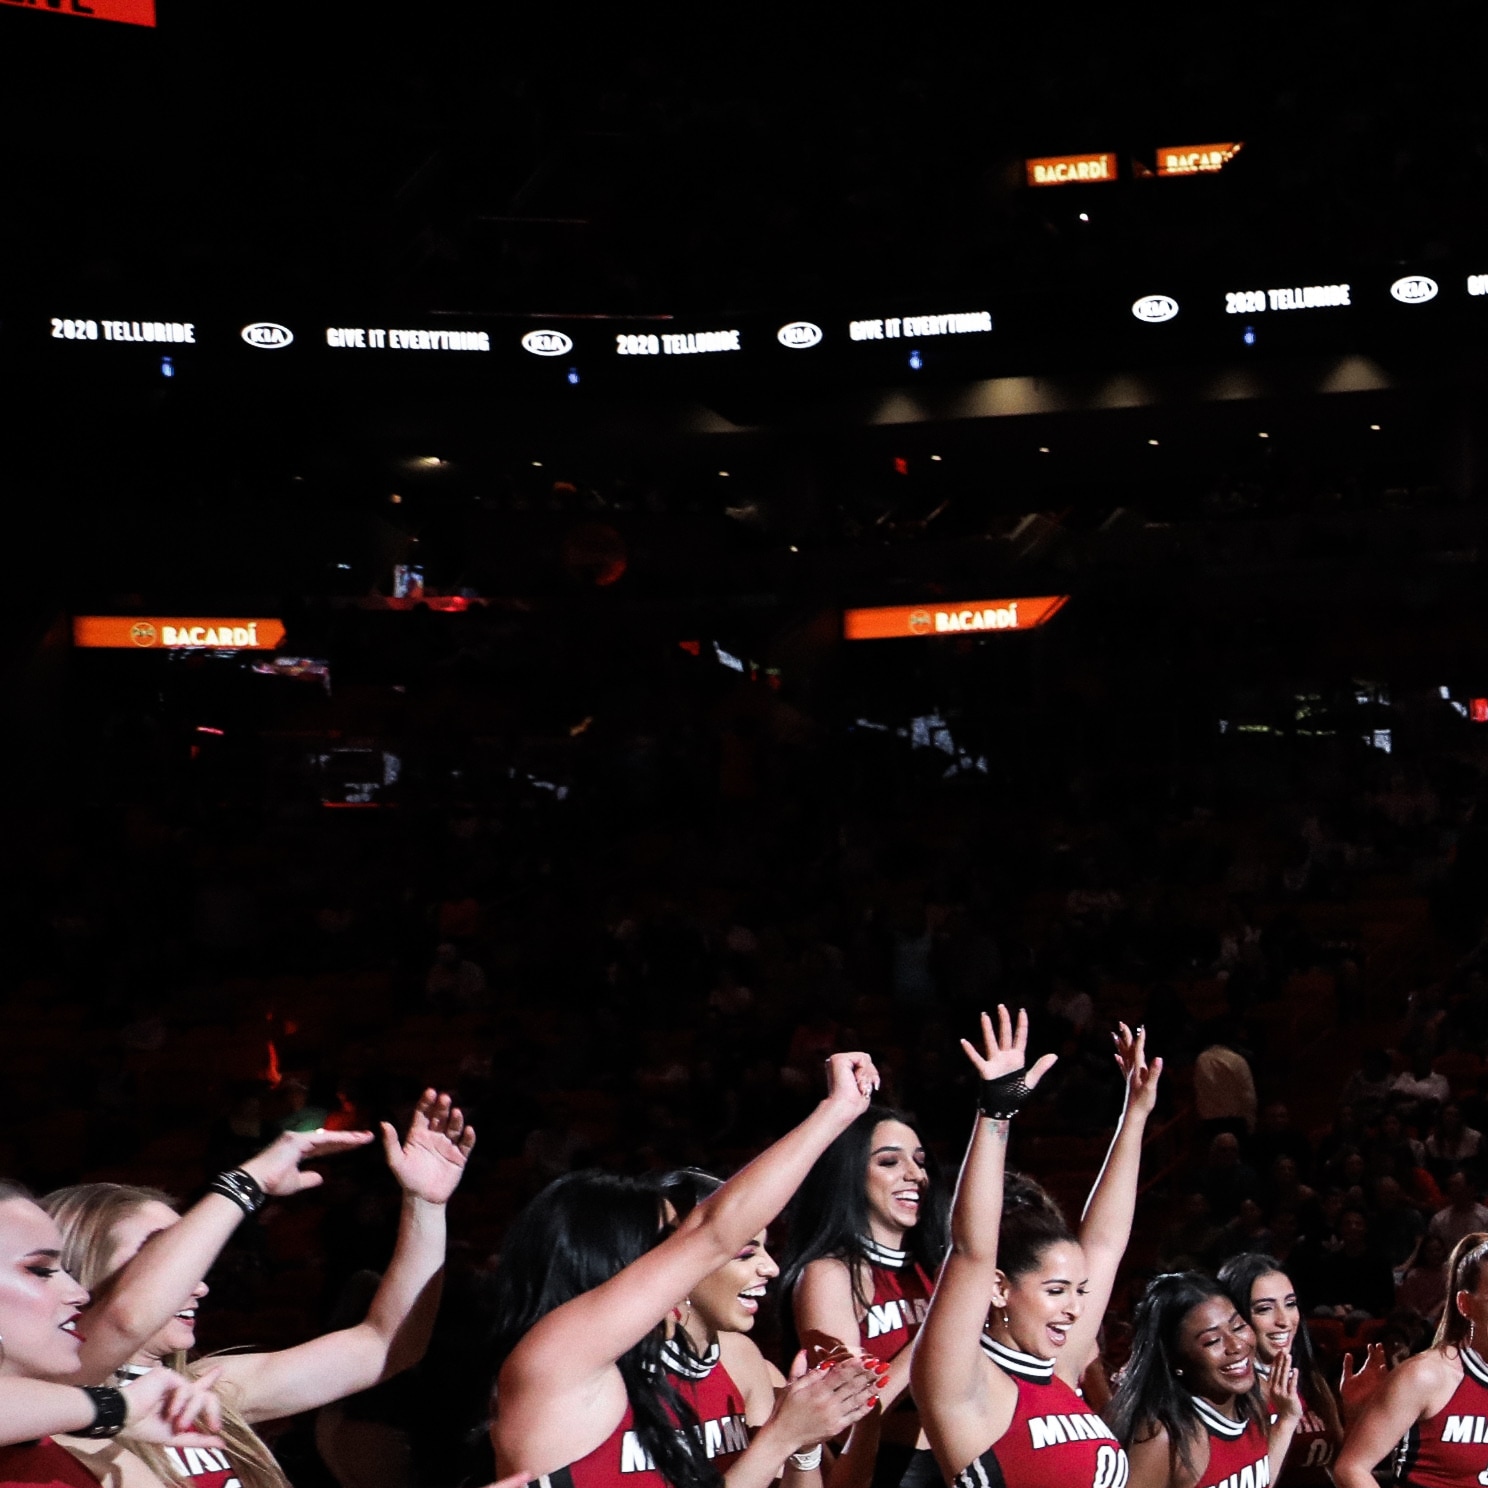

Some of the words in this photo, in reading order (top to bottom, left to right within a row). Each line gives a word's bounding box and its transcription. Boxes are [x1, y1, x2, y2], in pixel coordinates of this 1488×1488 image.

[367, 328, 387, 349] IT
[884, 317, 902, 339] IT
[867, 1298, 929, 1339] MIA
[1028, 1412, 1120, 1450] MIAM
